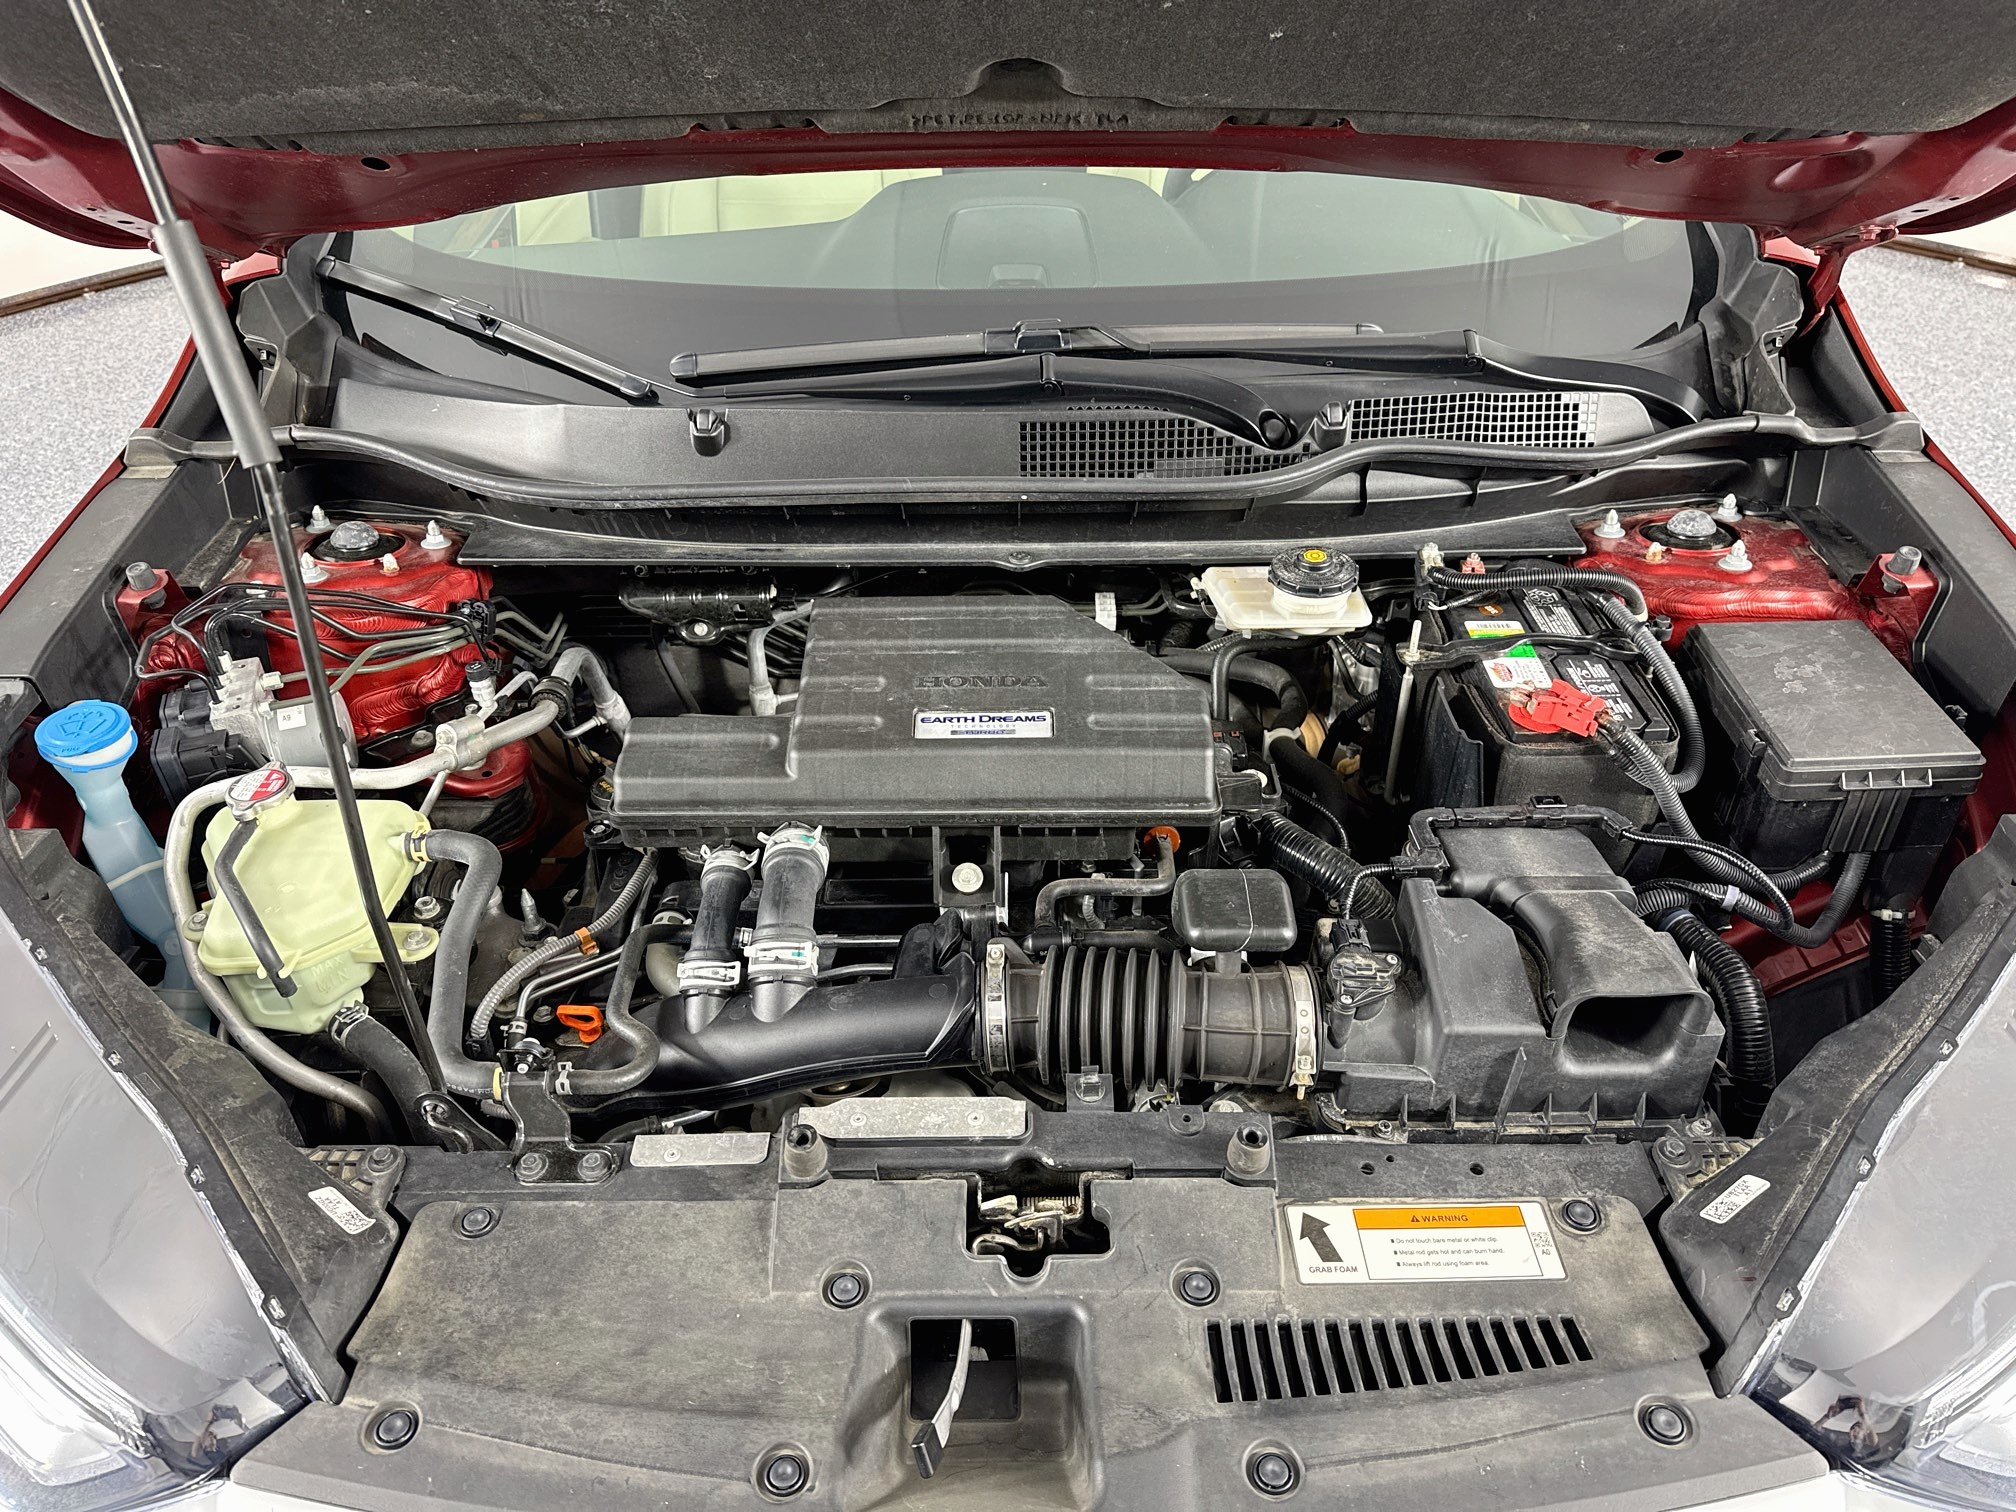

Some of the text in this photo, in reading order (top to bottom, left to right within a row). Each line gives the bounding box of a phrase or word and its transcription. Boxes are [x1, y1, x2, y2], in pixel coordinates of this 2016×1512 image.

[915, 675, 1049, 688] HONDA
[282, 714, 291, 722] A9
[920, 715, 1047, 724] EARTH DREAMS
[311, 956, 345, 977] MAX
[316, 967, 351, 993] MIN
[1421, 1215, 1468, 1223] WARNING
[1308, 1265, 1359, 1274] GRAB FOAM
